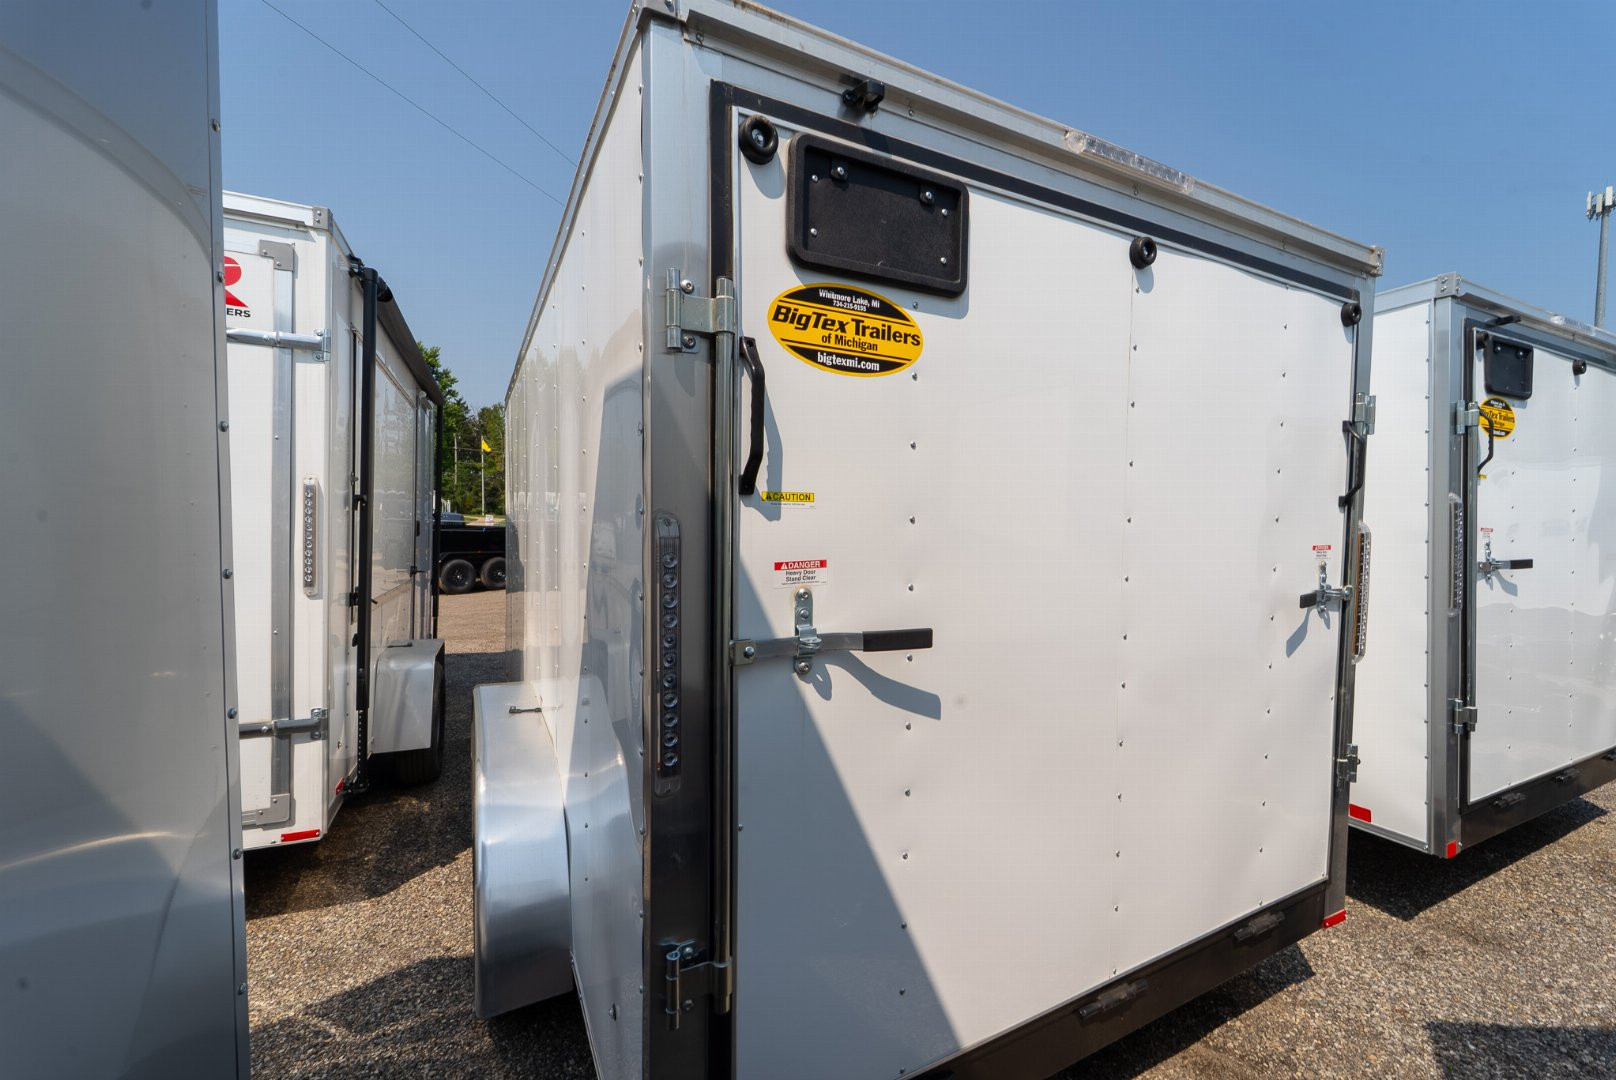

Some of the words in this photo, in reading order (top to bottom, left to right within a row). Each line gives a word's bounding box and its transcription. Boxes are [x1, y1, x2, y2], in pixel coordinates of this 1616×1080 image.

[818, 288, 851, 303] Whitmore
[852, 295, 870, 308] Lake,
[850, 318, 921, 347] Trailers
[821, 333, 832, 344] of
[834, 335, 878, 352] Michigan
[817, 352, 880, 371] bigtexmi.com
[773, 492, 811, 501] CAUTION
[788, 560, 821, 570] DANGER
